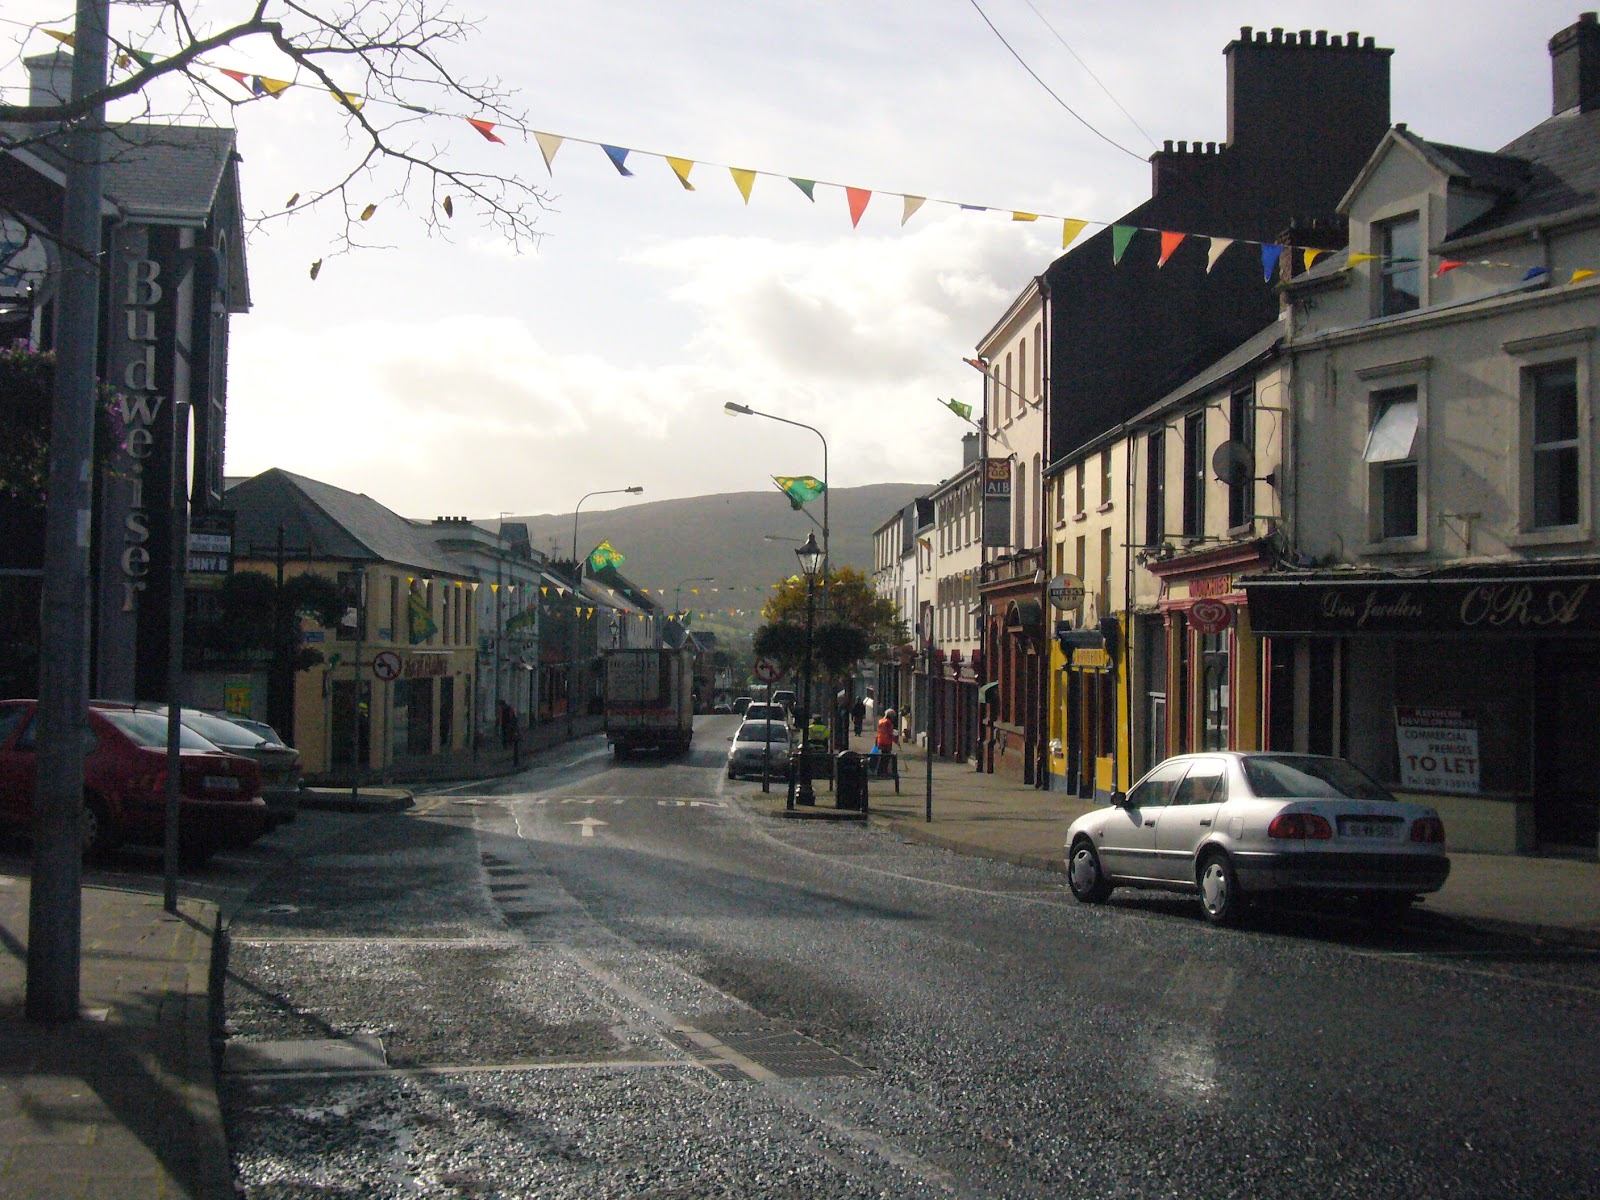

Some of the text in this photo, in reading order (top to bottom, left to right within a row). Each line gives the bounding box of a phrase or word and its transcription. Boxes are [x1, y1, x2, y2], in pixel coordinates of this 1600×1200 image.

[120, 259, 166, 612] Budweiser
[987, 481, 1010, 493] AIB
[1203, 623, 1216, 632] HB
[1404, 730, 1467, 741] COMMERCIAL
[1428, 744, 1473, 755] PREMISES
[1407, 755, 1478, 774] TO LET
